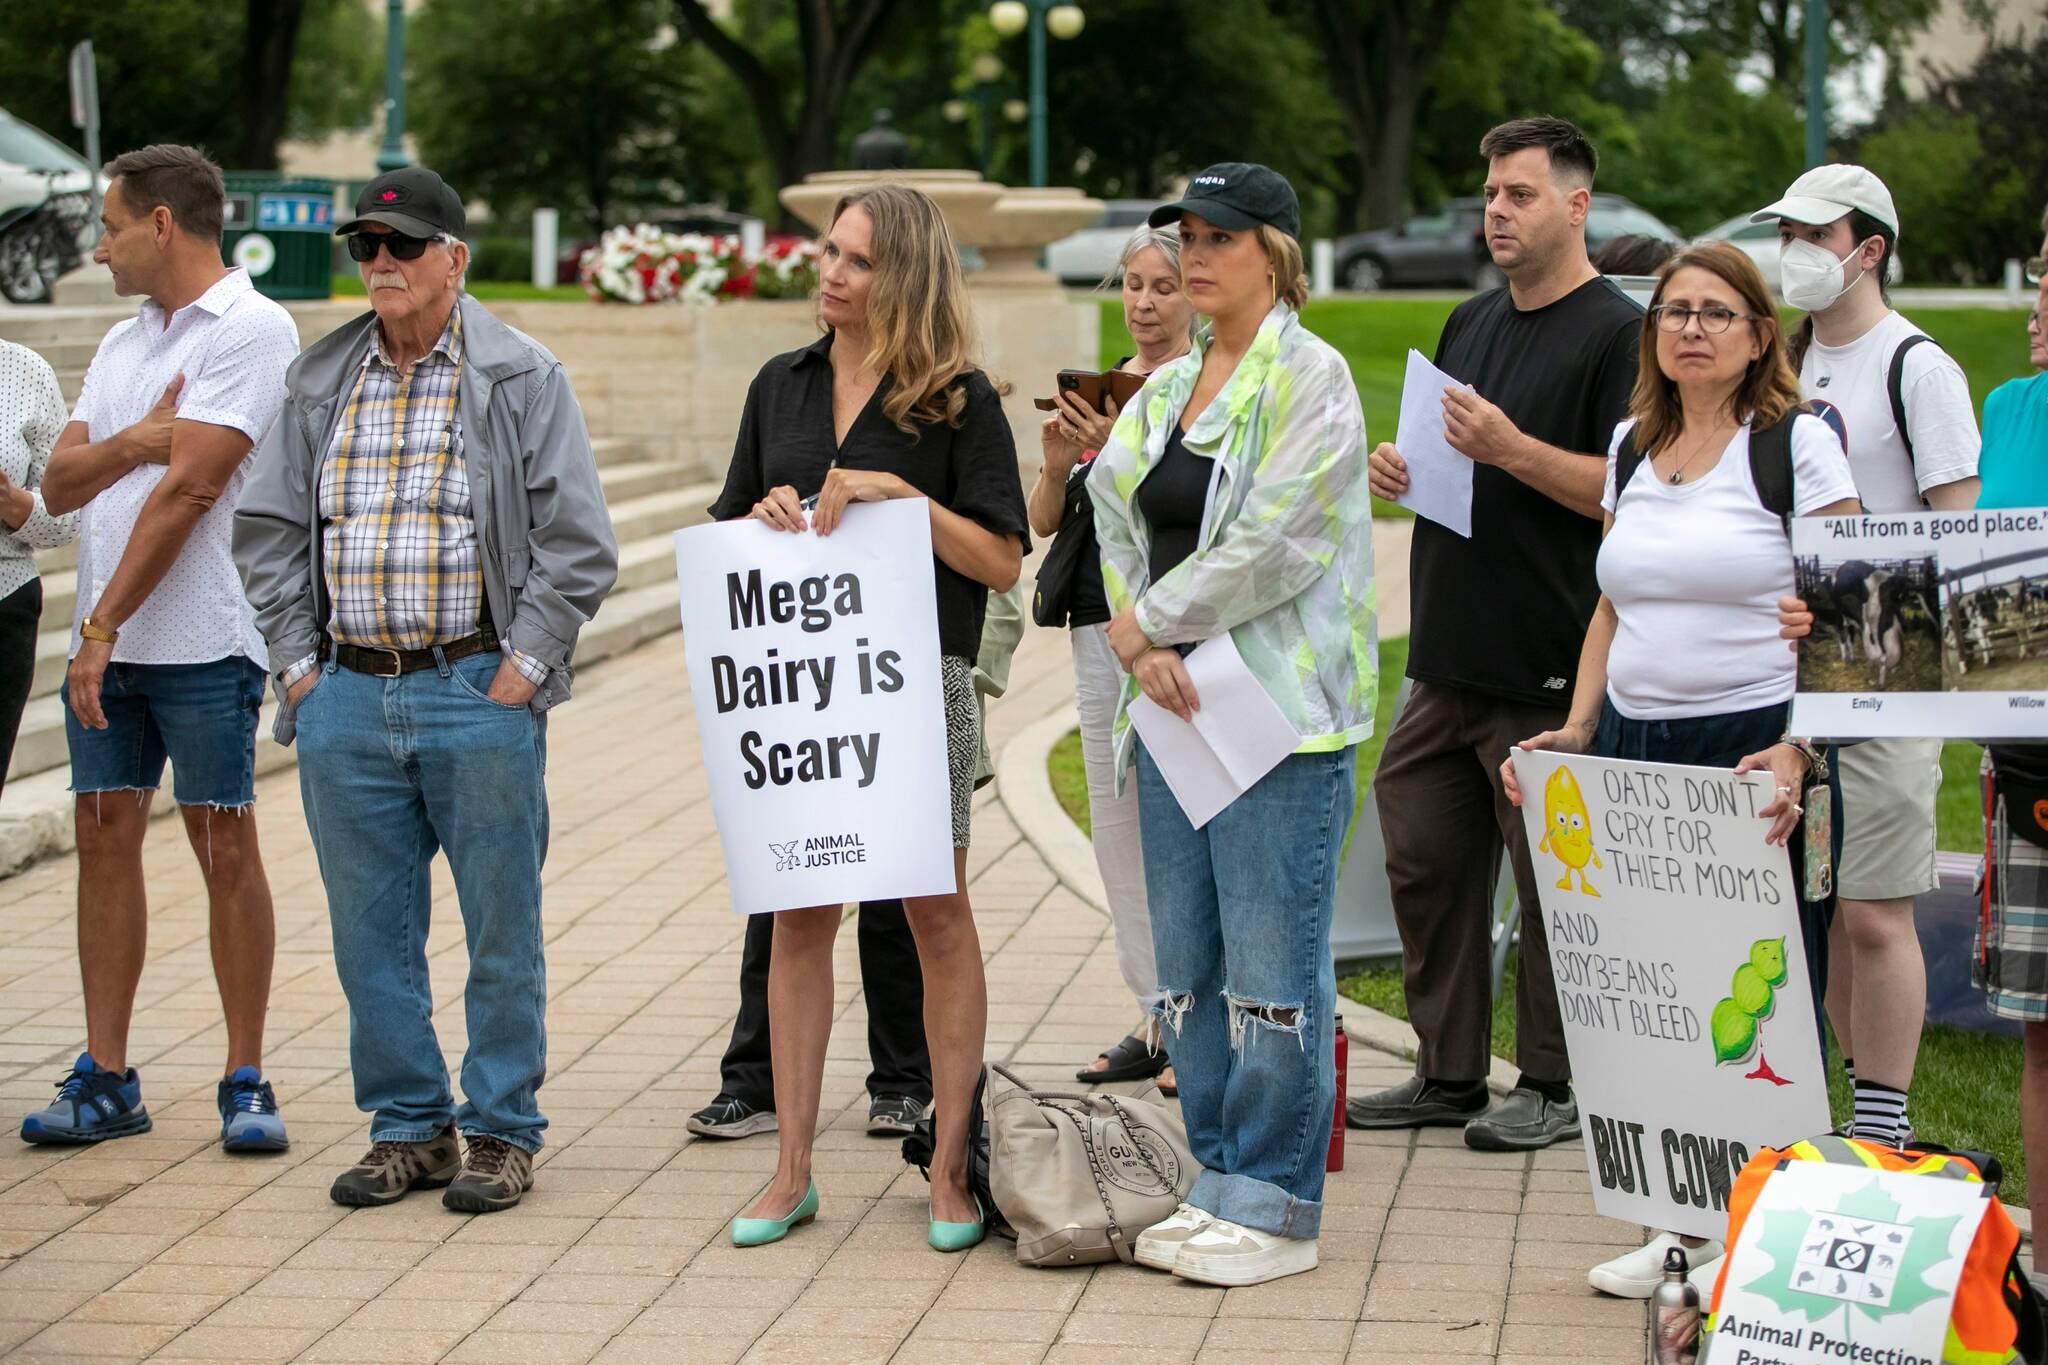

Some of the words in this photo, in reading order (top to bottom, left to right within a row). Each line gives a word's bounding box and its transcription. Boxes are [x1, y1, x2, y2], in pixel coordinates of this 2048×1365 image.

[1862, 517, 1908, 538] from
[1913, 519, 1925, 536] a
[1930, 513, 1979, 540] good
[726, 568, 863, 633] Mega
[711, 648, 836, 714] Dairy
[856, 637, 905, 695] is
[1852, 697, 1883, 711] Emily
[2008, 696, 2046, 709] Willow
[740, 730, 881, 790] Scary
[1603, 769, 1670, 810] OATS
[1684, 776, 1760, 819] DON'T
[804, 833, 865, 852] ANIMAL
[1605, 809, 1654, 848] CRY
[1664, 816, 1717, 856] FOR
[804, 850, 867, 869] JUSTICE
[1605, 848, 1686, 894] THIER
[1695, 862, 1781, 905] MOMS
[1552, 909, 1599, 946] AND
[1556, 949, 1677, 999] SOYBEANS
[1561, 989, 1622, 1032] DON'T
[1630, 999, 1701, 1042] BLEED
[1588, 1113, 1650, 1197] BUT
[1719, 1314, 1802, 1349] Animal
[1808, 1331, 1933, 1365] Protection
[1736, 1349, 1794, 1365] Part
